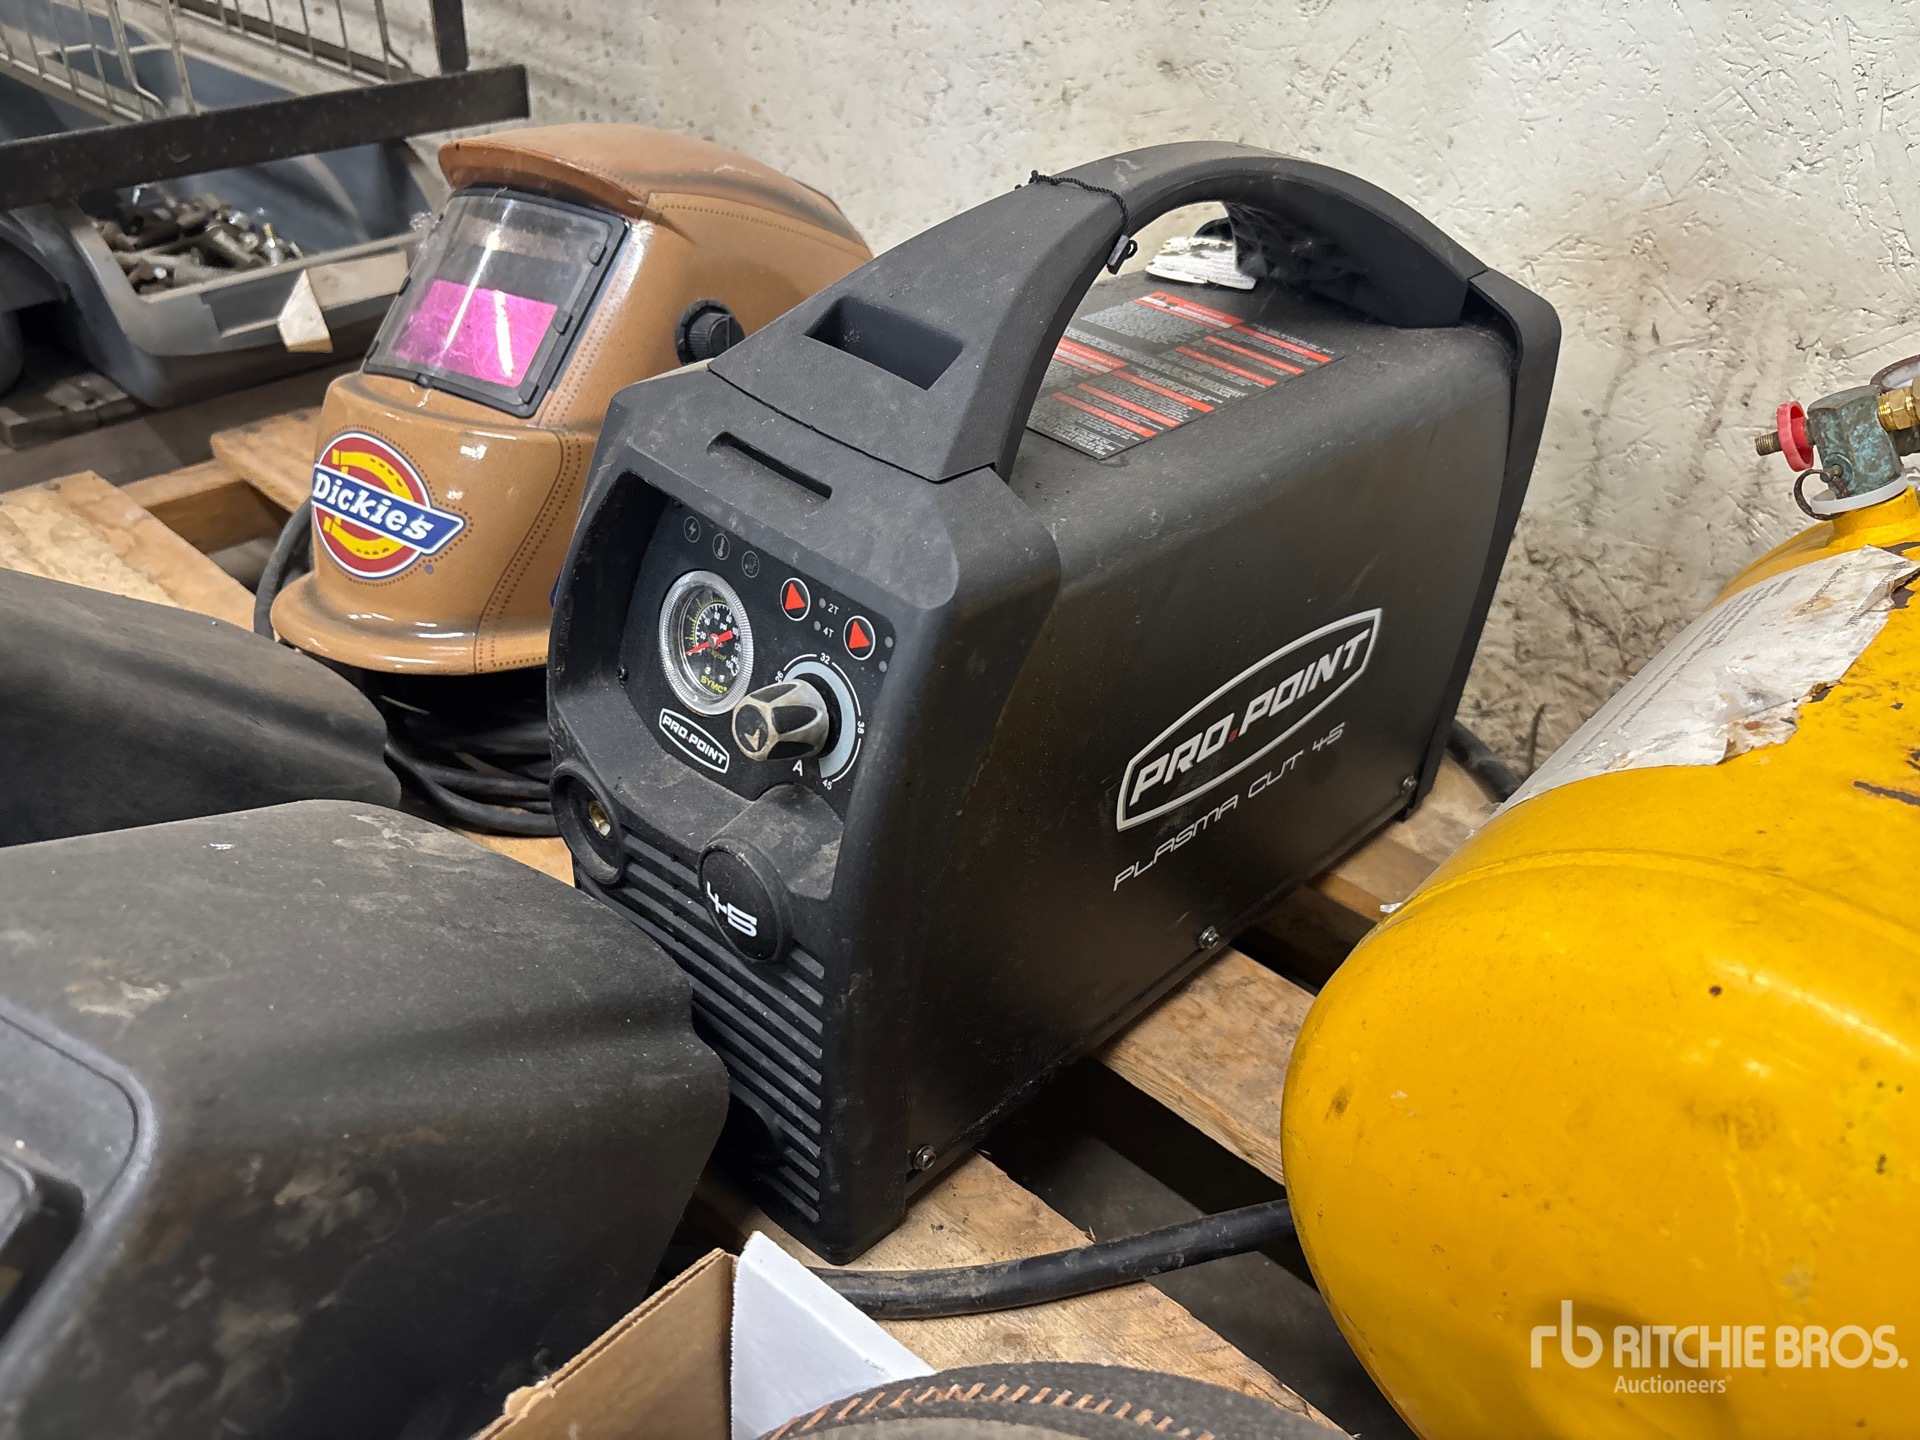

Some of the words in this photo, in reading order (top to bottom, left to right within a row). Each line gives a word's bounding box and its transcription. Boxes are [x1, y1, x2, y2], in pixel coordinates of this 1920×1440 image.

[313, 473, 435, 540] Dickies
[827, 603, 840, 616] 2T
[822, 626, 834, 638] 4T
[819, 652, 831, 665] 32
[774, 670, 785, 684] 26
[1129, 628, 1371, 807] PRO.POINT
[856, 720, 865, 734] 38
[662, 715, 727, 765] PRO.POINT
[791, 759, 804, 777] A
[821, 778, 834, 791] 45
[1113, 794, 1239, 892] PLASMA
[1247, 749, 1304, 799] CUT
[706, 880, 758, 938] 45
